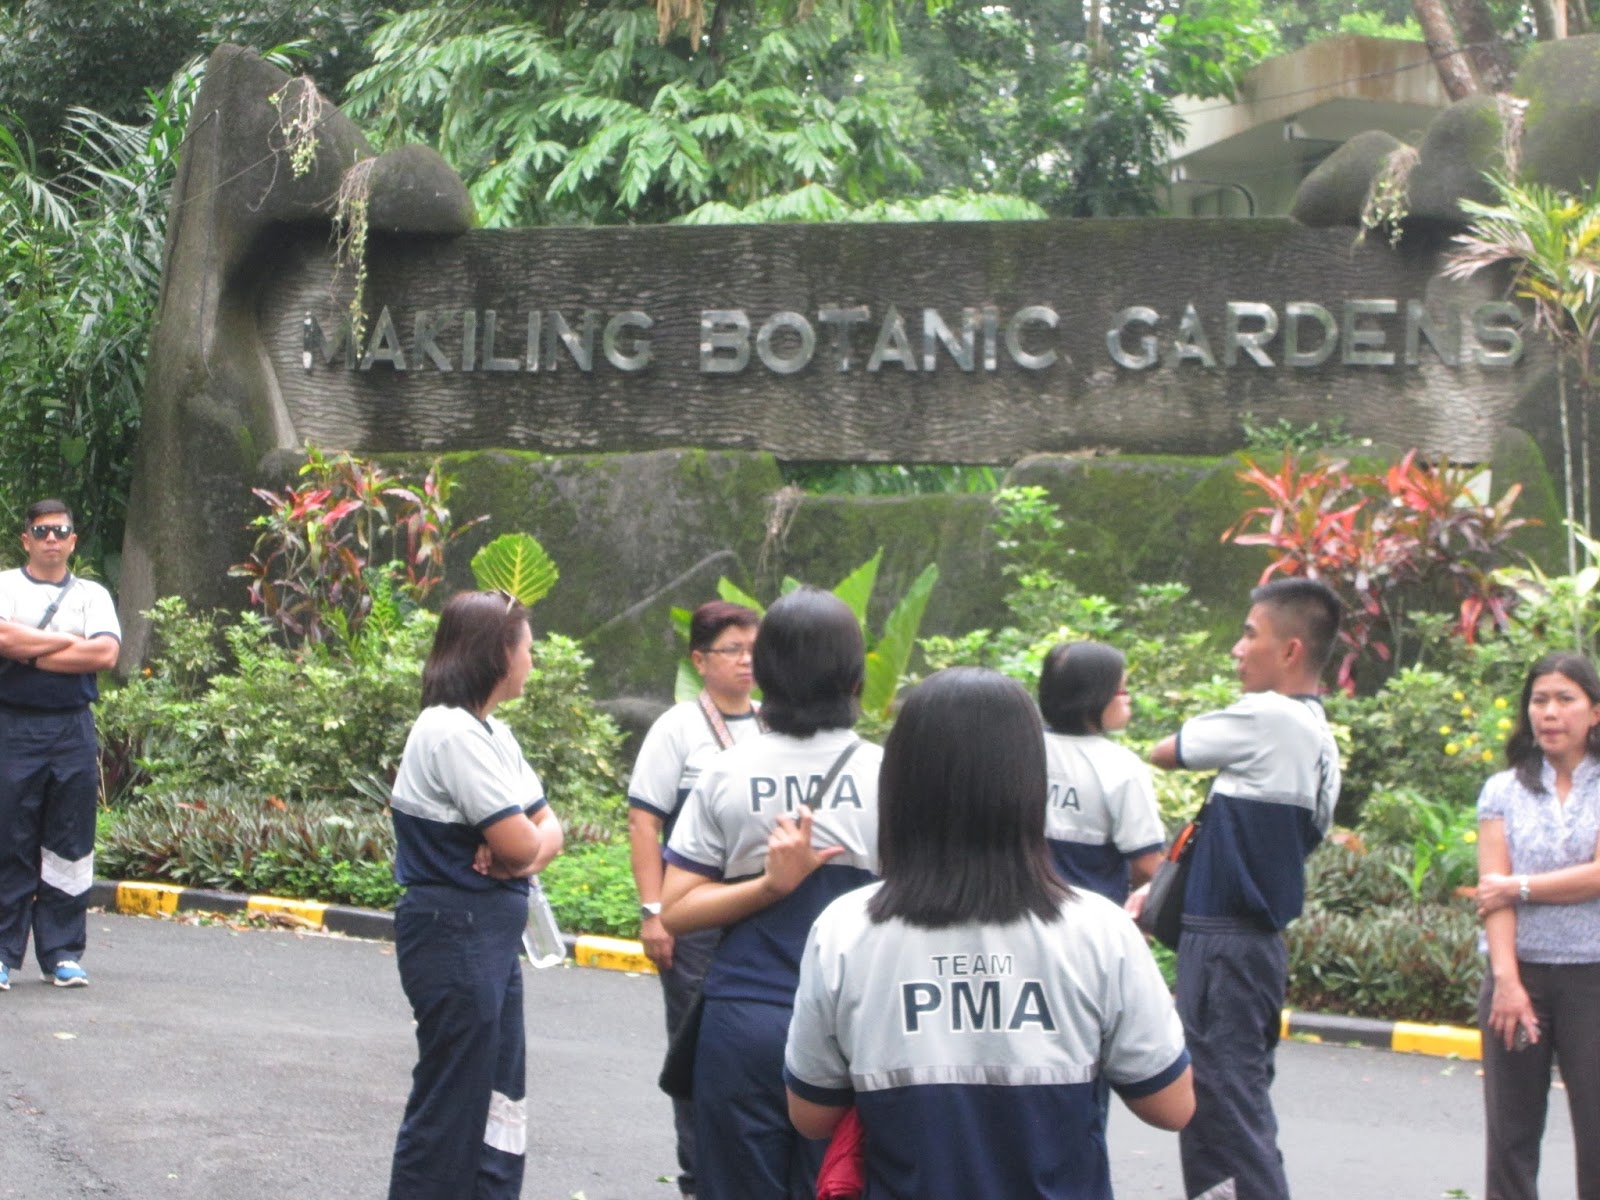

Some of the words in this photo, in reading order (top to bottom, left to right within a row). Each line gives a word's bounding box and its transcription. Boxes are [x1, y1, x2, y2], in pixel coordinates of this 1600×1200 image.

[302, 304, 655, 371] MAKILING
[700, 304, 1060, 373] BOTANIC
[1106, 299, 1525, 370] GARDENS
[749, 774, 863, 812] PMA
[932, 955, 1012, 976] TEAM
[903, 981, 1056, 1031] PMA
